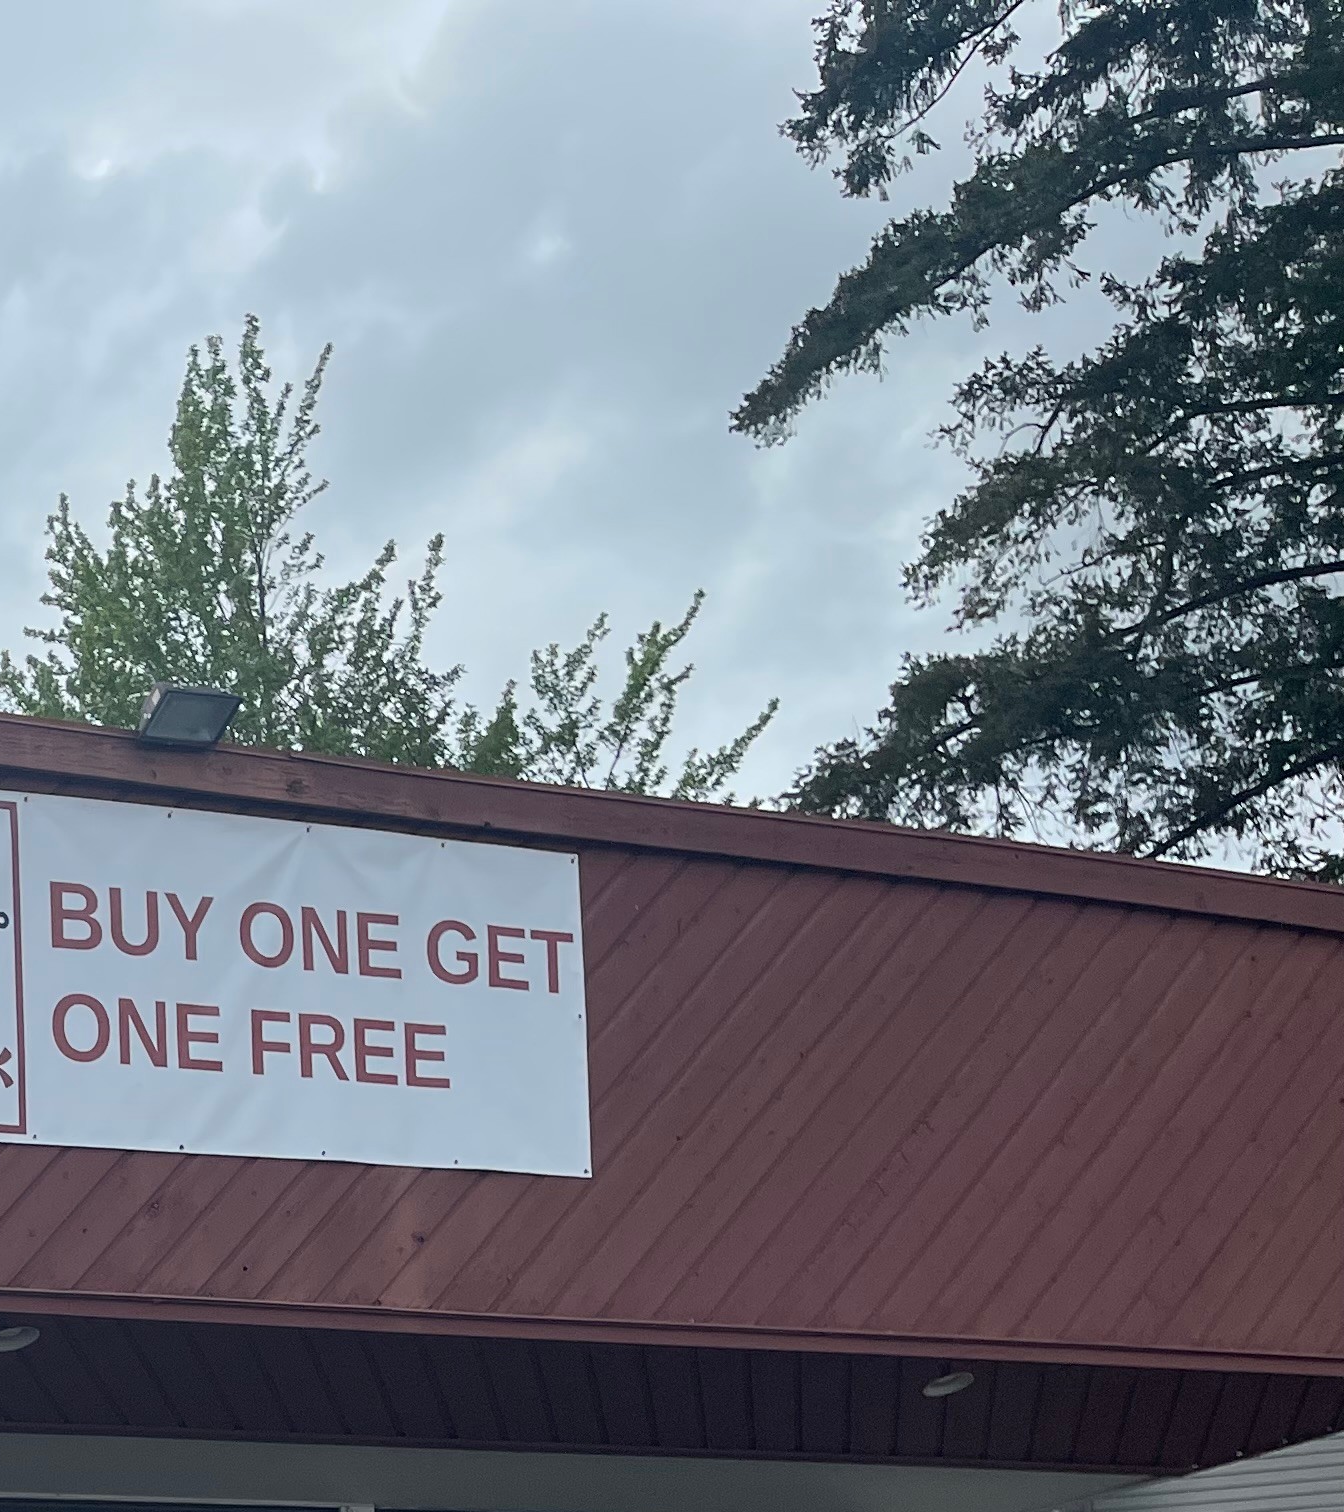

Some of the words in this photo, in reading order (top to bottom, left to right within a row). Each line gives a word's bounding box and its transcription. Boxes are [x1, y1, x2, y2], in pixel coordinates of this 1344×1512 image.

[49, 881, 215, 961] BUY
[238, 901, 403, 980] ONE
[425, 919, 575, 995] GET
[50, 993, 224, 1073] ONE
[250, 1009, 452, 1090] FREE
